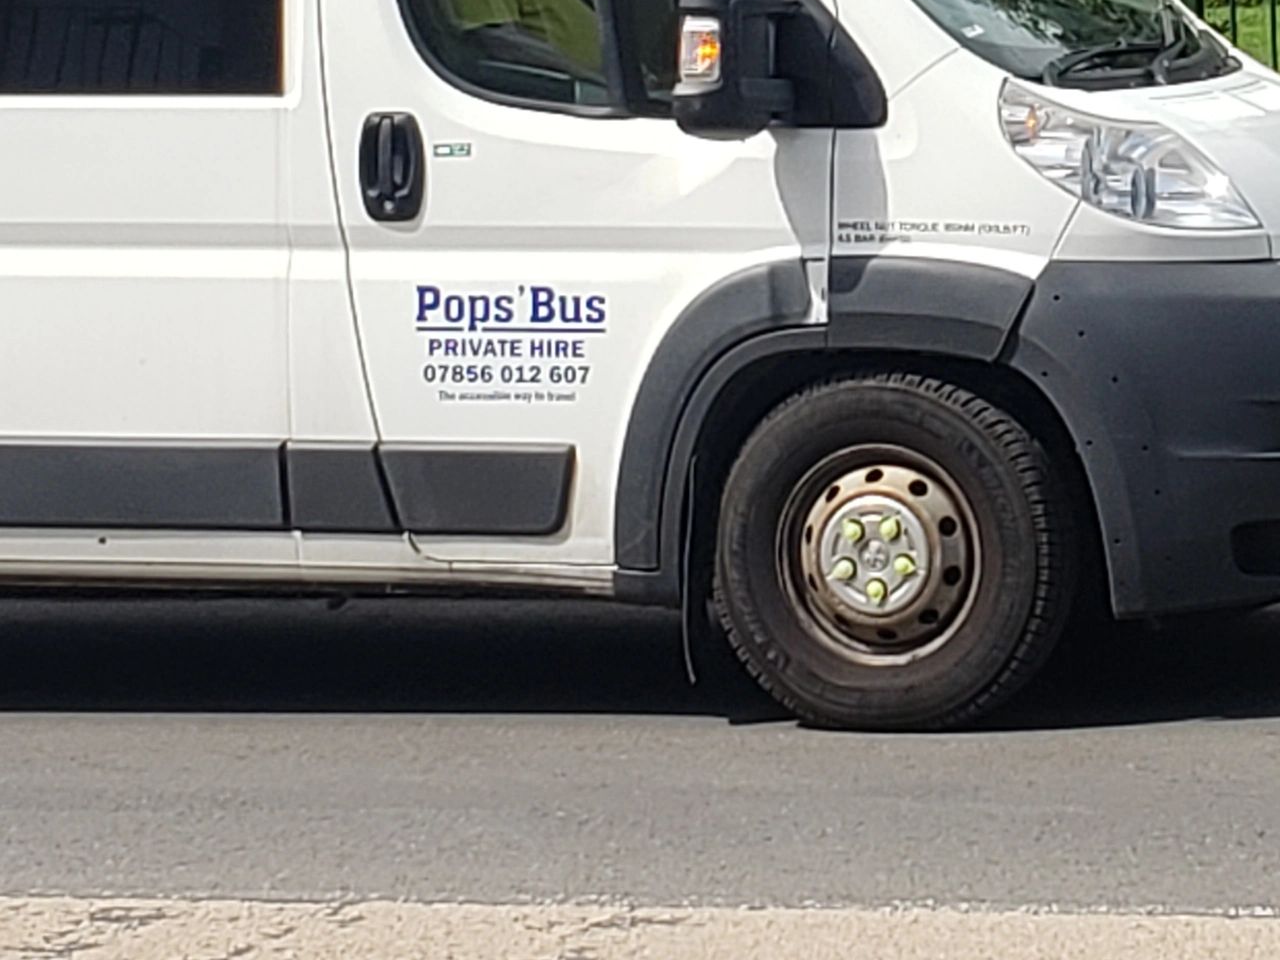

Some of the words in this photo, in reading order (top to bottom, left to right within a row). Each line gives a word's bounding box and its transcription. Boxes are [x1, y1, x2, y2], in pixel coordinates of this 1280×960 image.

[899, 222, 939, 232] TORQUE
[529, 286, 607, 324] Bus
[428, 339, 523, 357] PRIVATE
[530, 340, 585, 358] HIRE
[423, 365, 494, 383] 07856
[500, 366, 542, 383] 012
[549, 366, 591, 384] 607
[438, 390, 456, 401] The
[514, 391, 532, 404] way
[534, 391, 545, 401] to
